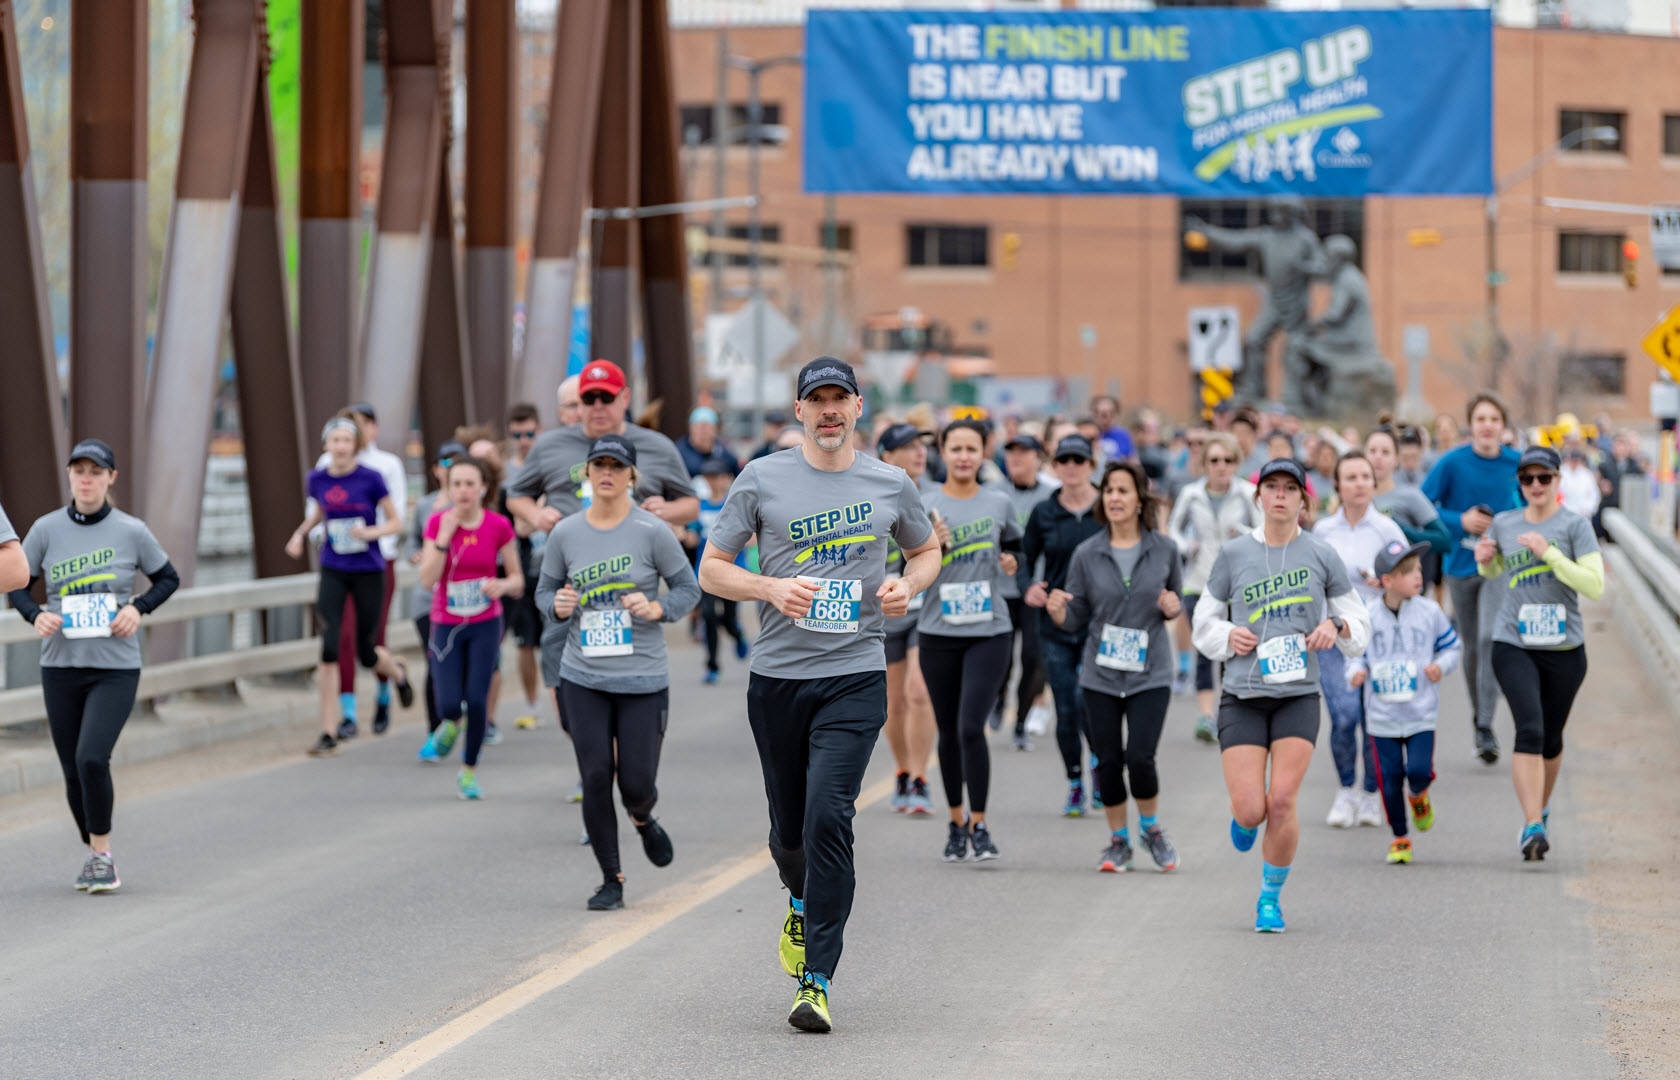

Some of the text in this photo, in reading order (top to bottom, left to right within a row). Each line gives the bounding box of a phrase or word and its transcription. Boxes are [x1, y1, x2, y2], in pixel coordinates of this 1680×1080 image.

[908, 24, 1190, 61] THE FINISH LINE
[908, 63, 1127, 101] IS NEAR BUT
[1184, 26, 1370, 127] STEP UP
[908, 103, 1083, 140] YOU HAVE
[907, 144, 1158, 180] ALREADY WON
[789, 501, 873, 541] STEP UP
[973, 516, 994, 537] UP
[794, 523, 872, 549] FOR MENTAL HEALTH
[50, 547, 115, 583] STEP UP
[572, 553, 633, 587] STEP UP
[828, 580, 855, 600] 5K
[965, 582, 983, 598] 5K
[1242, 567, 1310, 604] STEP UP
[1286, 587, 1310, 597] HEALTH
[88, 594, 108, 612] 5K
[1541, 604, 1558, 621] 5K
[69, 611, 110, 627] 1618
[603, 611, 624, 628] 5K
[803, 619, 848, 630] TEAMSOBER
[586, 628, 624, 646] 0981
[1123, 629, 1140, 645] 5K
[1284, 635, 1301, 653] 5K
[1373, 625, 1426, 658] GAP
[1267, 652, 1305, 673] 0995
[1392, 661, 1408, 678] 5K
